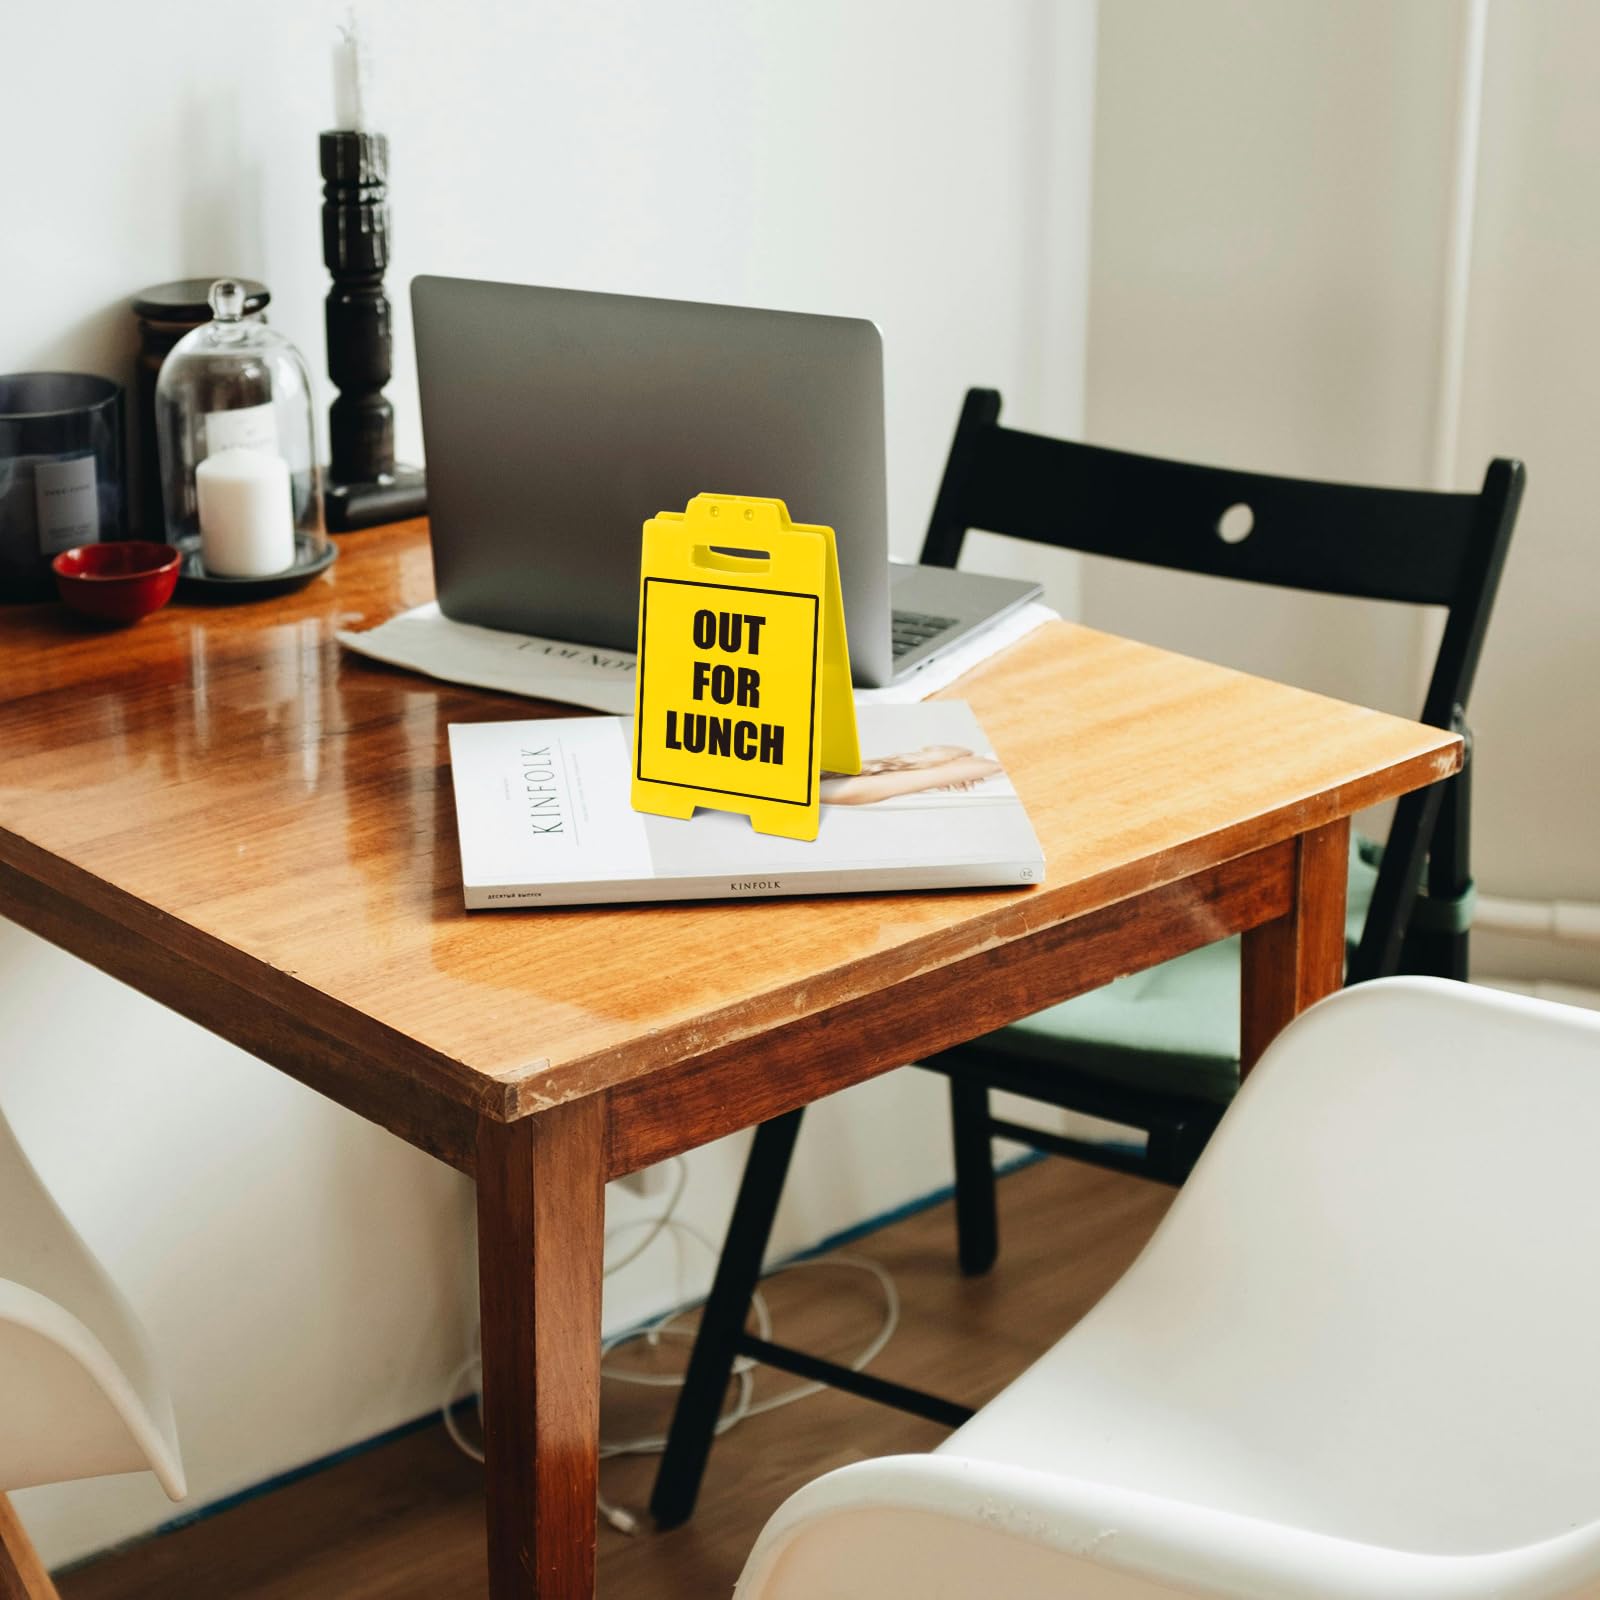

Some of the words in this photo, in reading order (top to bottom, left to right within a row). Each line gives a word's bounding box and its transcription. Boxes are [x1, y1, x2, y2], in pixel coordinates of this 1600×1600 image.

[694, 610, 765, 655] OUT
[693, 662, 760, 708] FOR
[666, 711, 784, 765] LUNCH
[522, 747, 563, 834] KINFOLK
[731, 882, 780, 890] KINFOLK
